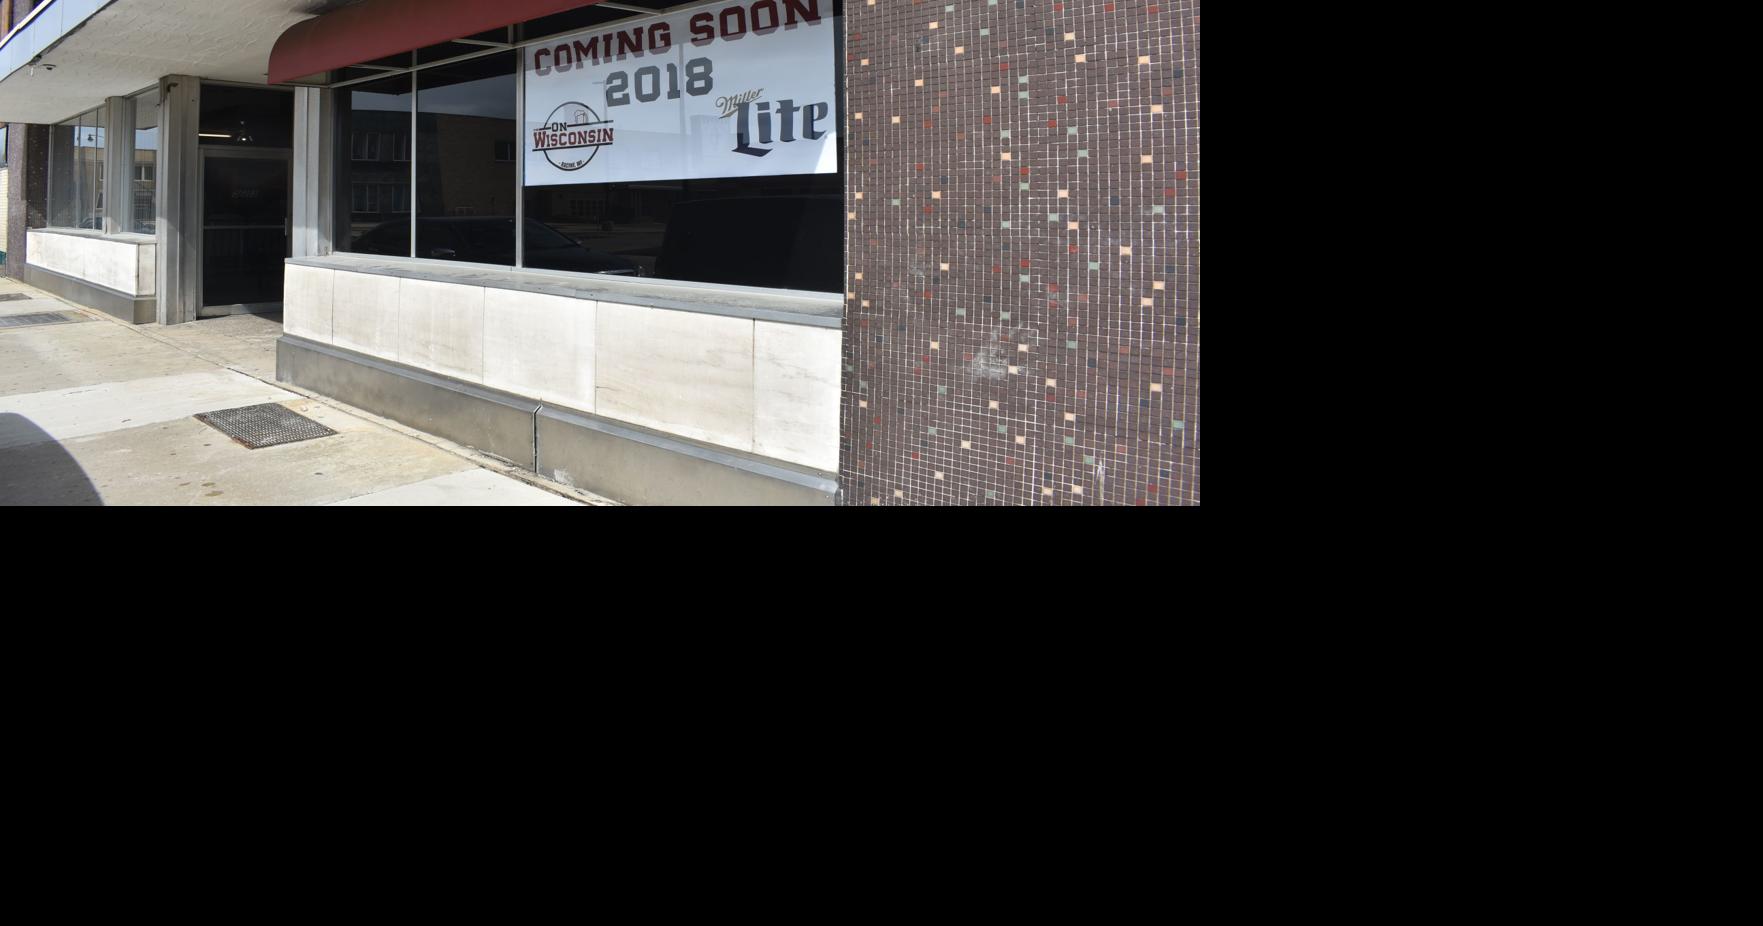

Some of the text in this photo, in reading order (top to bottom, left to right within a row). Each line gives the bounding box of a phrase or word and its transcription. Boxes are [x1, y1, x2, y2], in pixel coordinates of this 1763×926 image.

[534, 0, 822, 76] COMING SOON
[606, 57, 714, 107] 2018
[715, 88, 764, 116] Miller
[533, 128, 614, 149] WISCONSIN
[551, 122, 568, 132] ON
[731, 99, 829, 157] Lite
